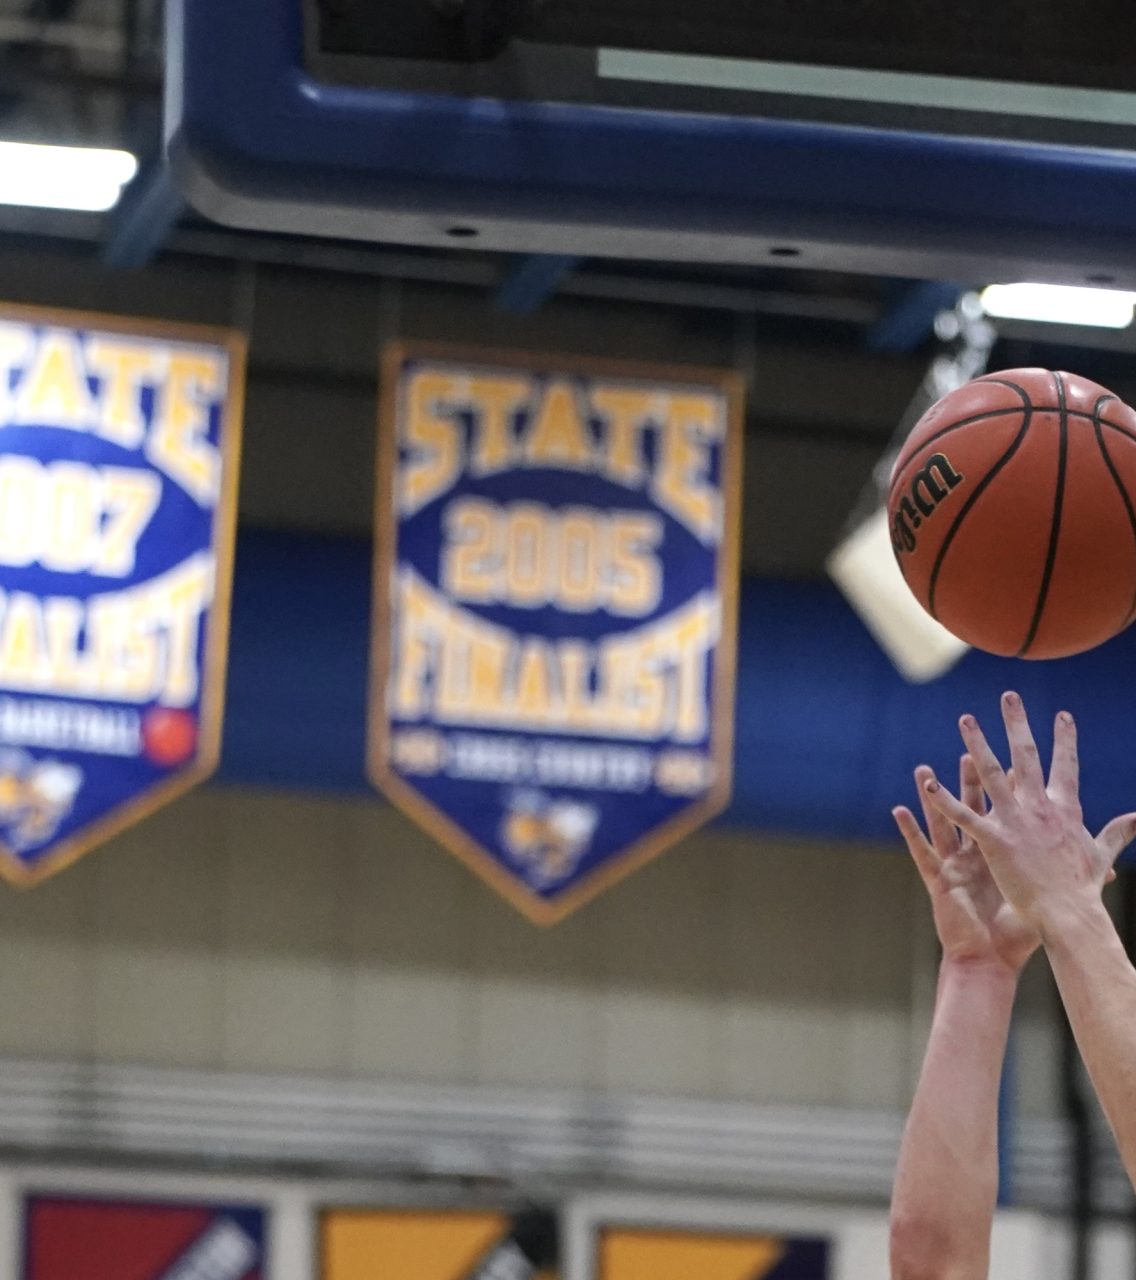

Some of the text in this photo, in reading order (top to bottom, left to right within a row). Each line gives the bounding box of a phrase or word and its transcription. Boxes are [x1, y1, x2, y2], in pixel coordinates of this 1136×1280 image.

[0, 320, 227, 507] TATE
[399, 364, 722, 546] STATE
[0, 452, 163, 579] 007
[442, 496, 664, 618] 2005
[0, 548, 217, 708] ALIST
[389, 562, 721, 742] FINALIST
